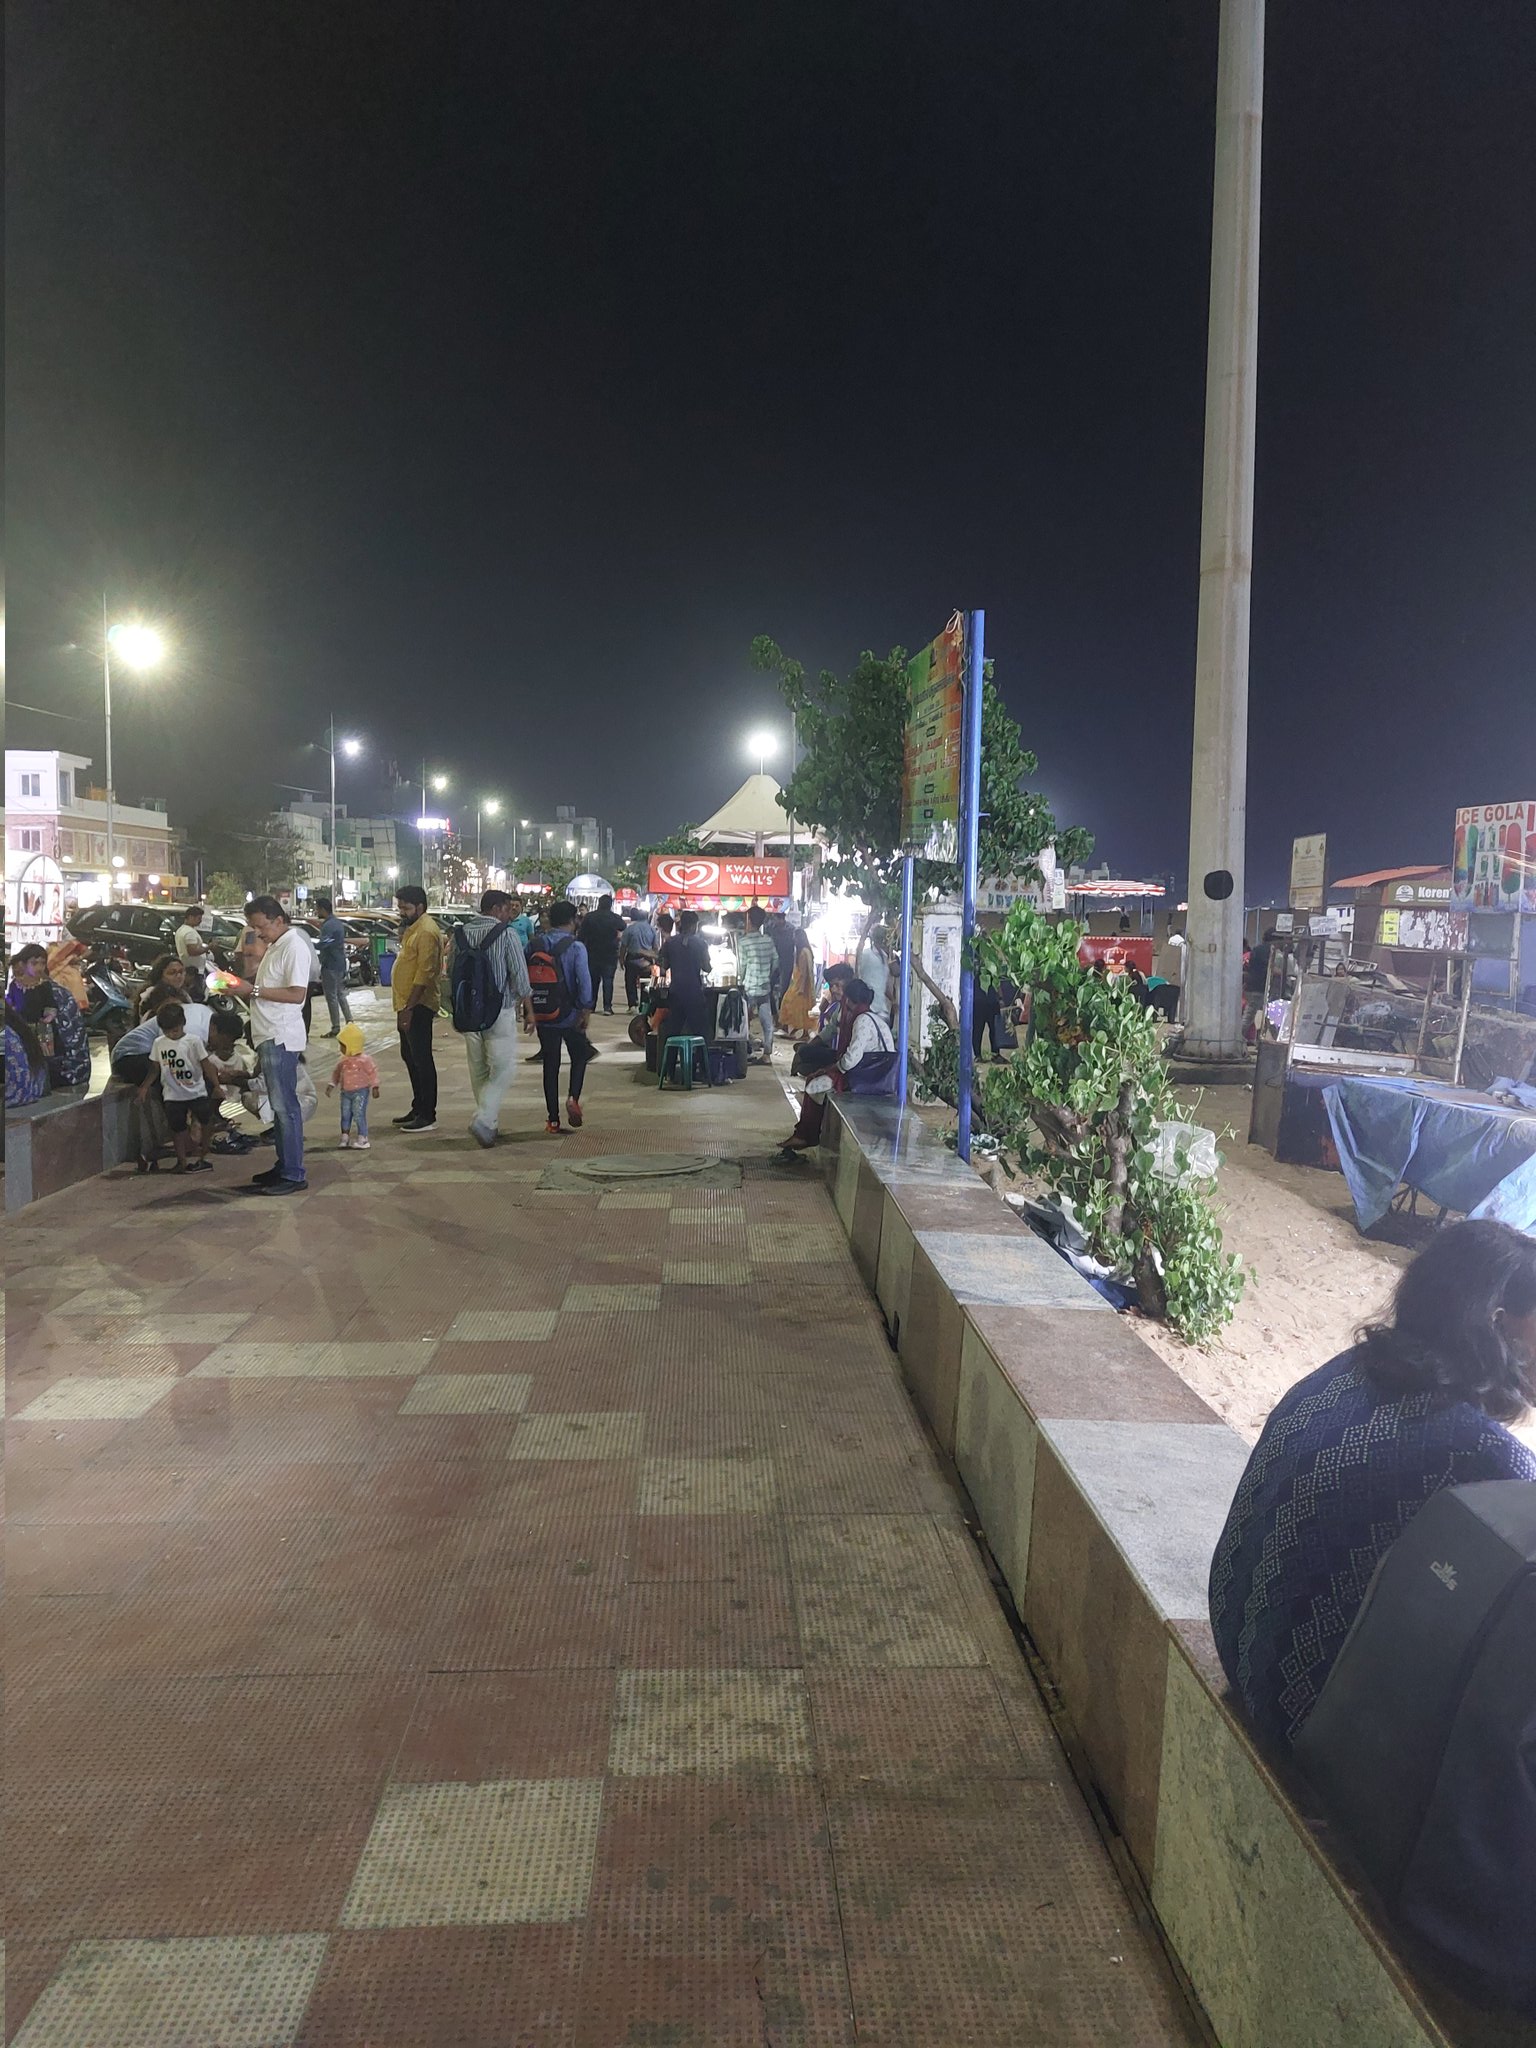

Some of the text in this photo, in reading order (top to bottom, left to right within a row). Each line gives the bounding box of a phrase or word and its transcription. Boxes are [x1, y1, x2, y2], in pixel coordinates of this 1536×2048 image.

[1456, 803, 1524, 826] ICE GOLA
[730, 873, 774, 886] WALL'S
[161, 1050, 177, 1060] HO
[168, 1059, 185, 1068] HO
[176, 1070, 192, 1080] HO
